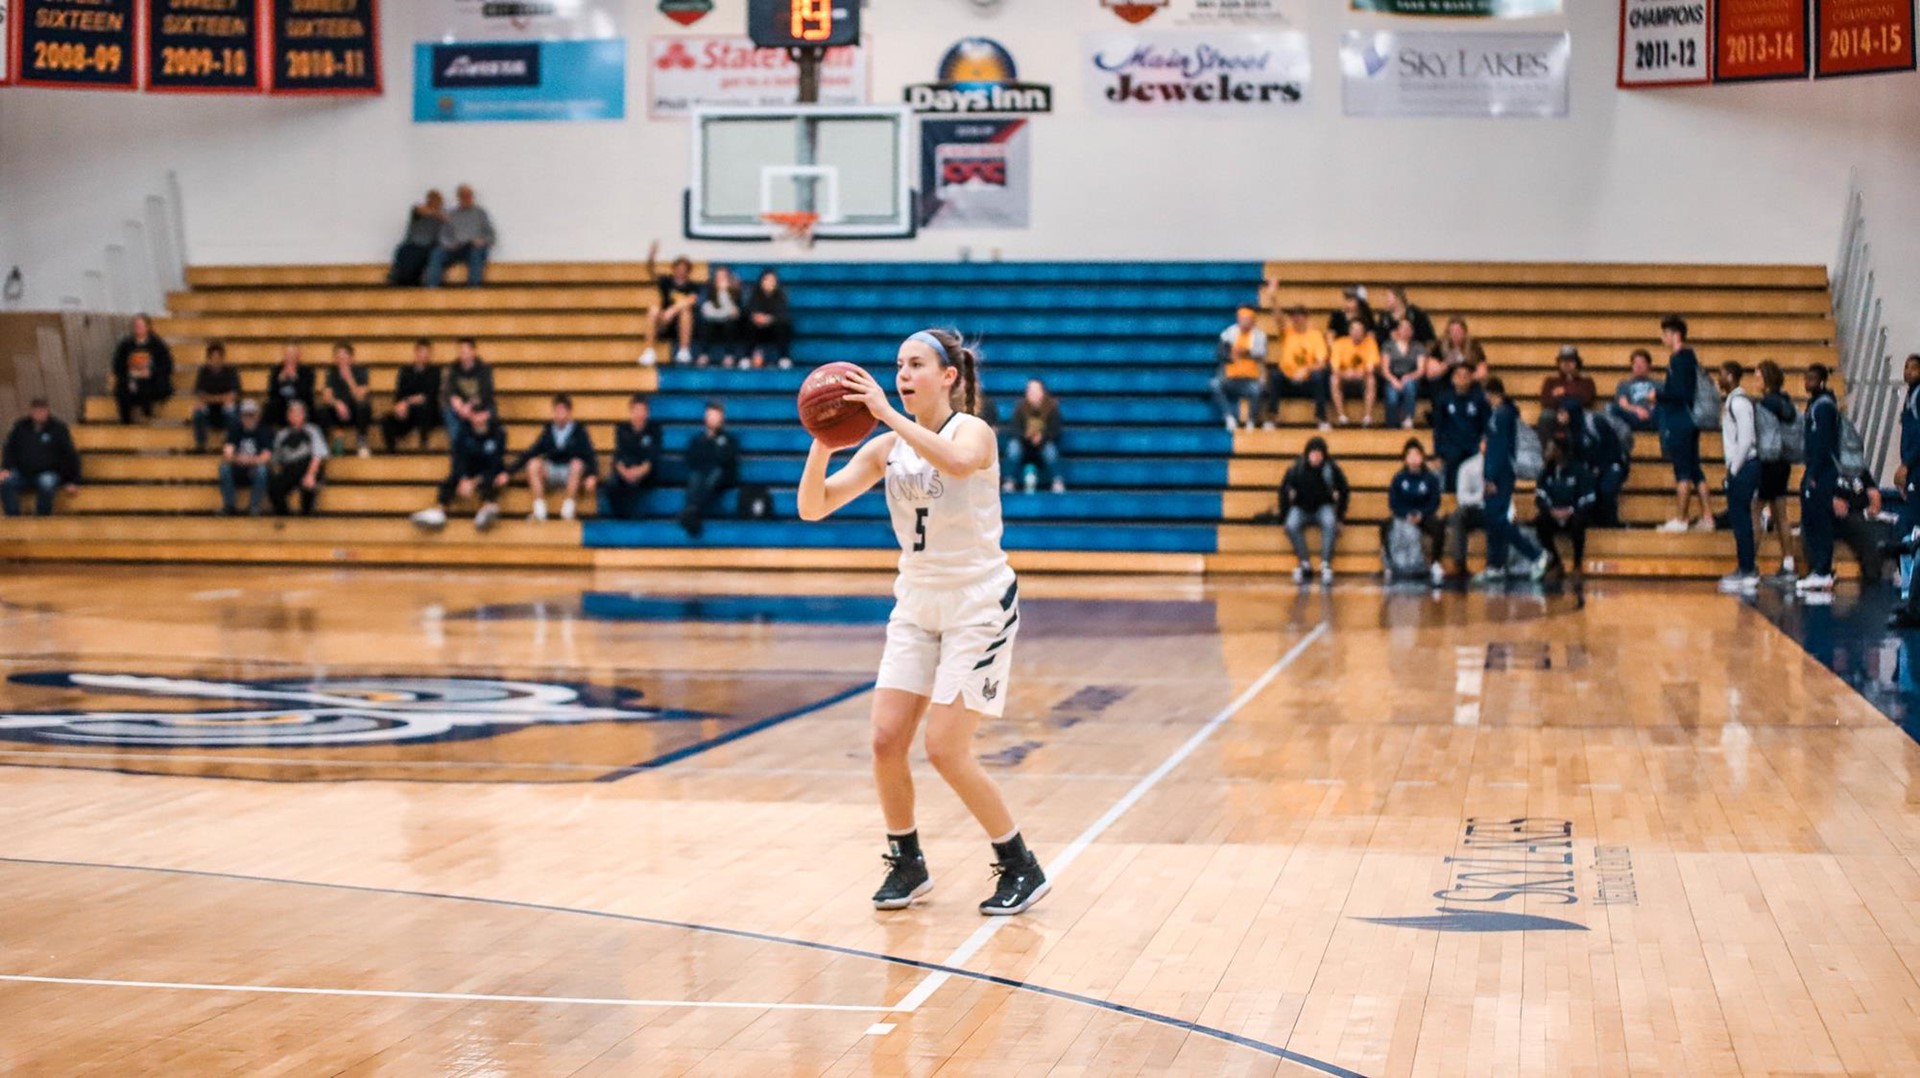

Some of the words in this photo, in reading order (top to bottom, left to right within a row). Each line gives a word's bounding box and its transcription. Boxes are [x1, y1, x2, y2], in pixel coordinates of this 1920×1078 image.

[35, 8, 124, 32] SIXTEEN
[1629, 4, 1704, 28] CHAMPIONS
[703, 41, 778, 69] State
[1636, 38, 1696, 68] 2011-12
[1727, 31, 1795, 64] 2013-14
[1829, 24, 1902, 58] 2014-15
[34, 41, 121, 72] 2008-09
[1094, 44, 1189, 72] Main
[1399, 49, 1447, 77] SKY
[911, 86, 988, 112] Days
[991, 85, 1047, 110] Inn
[1106, 74, 1301, 101] Jewelers
[913, 507, 929, 552] 5
